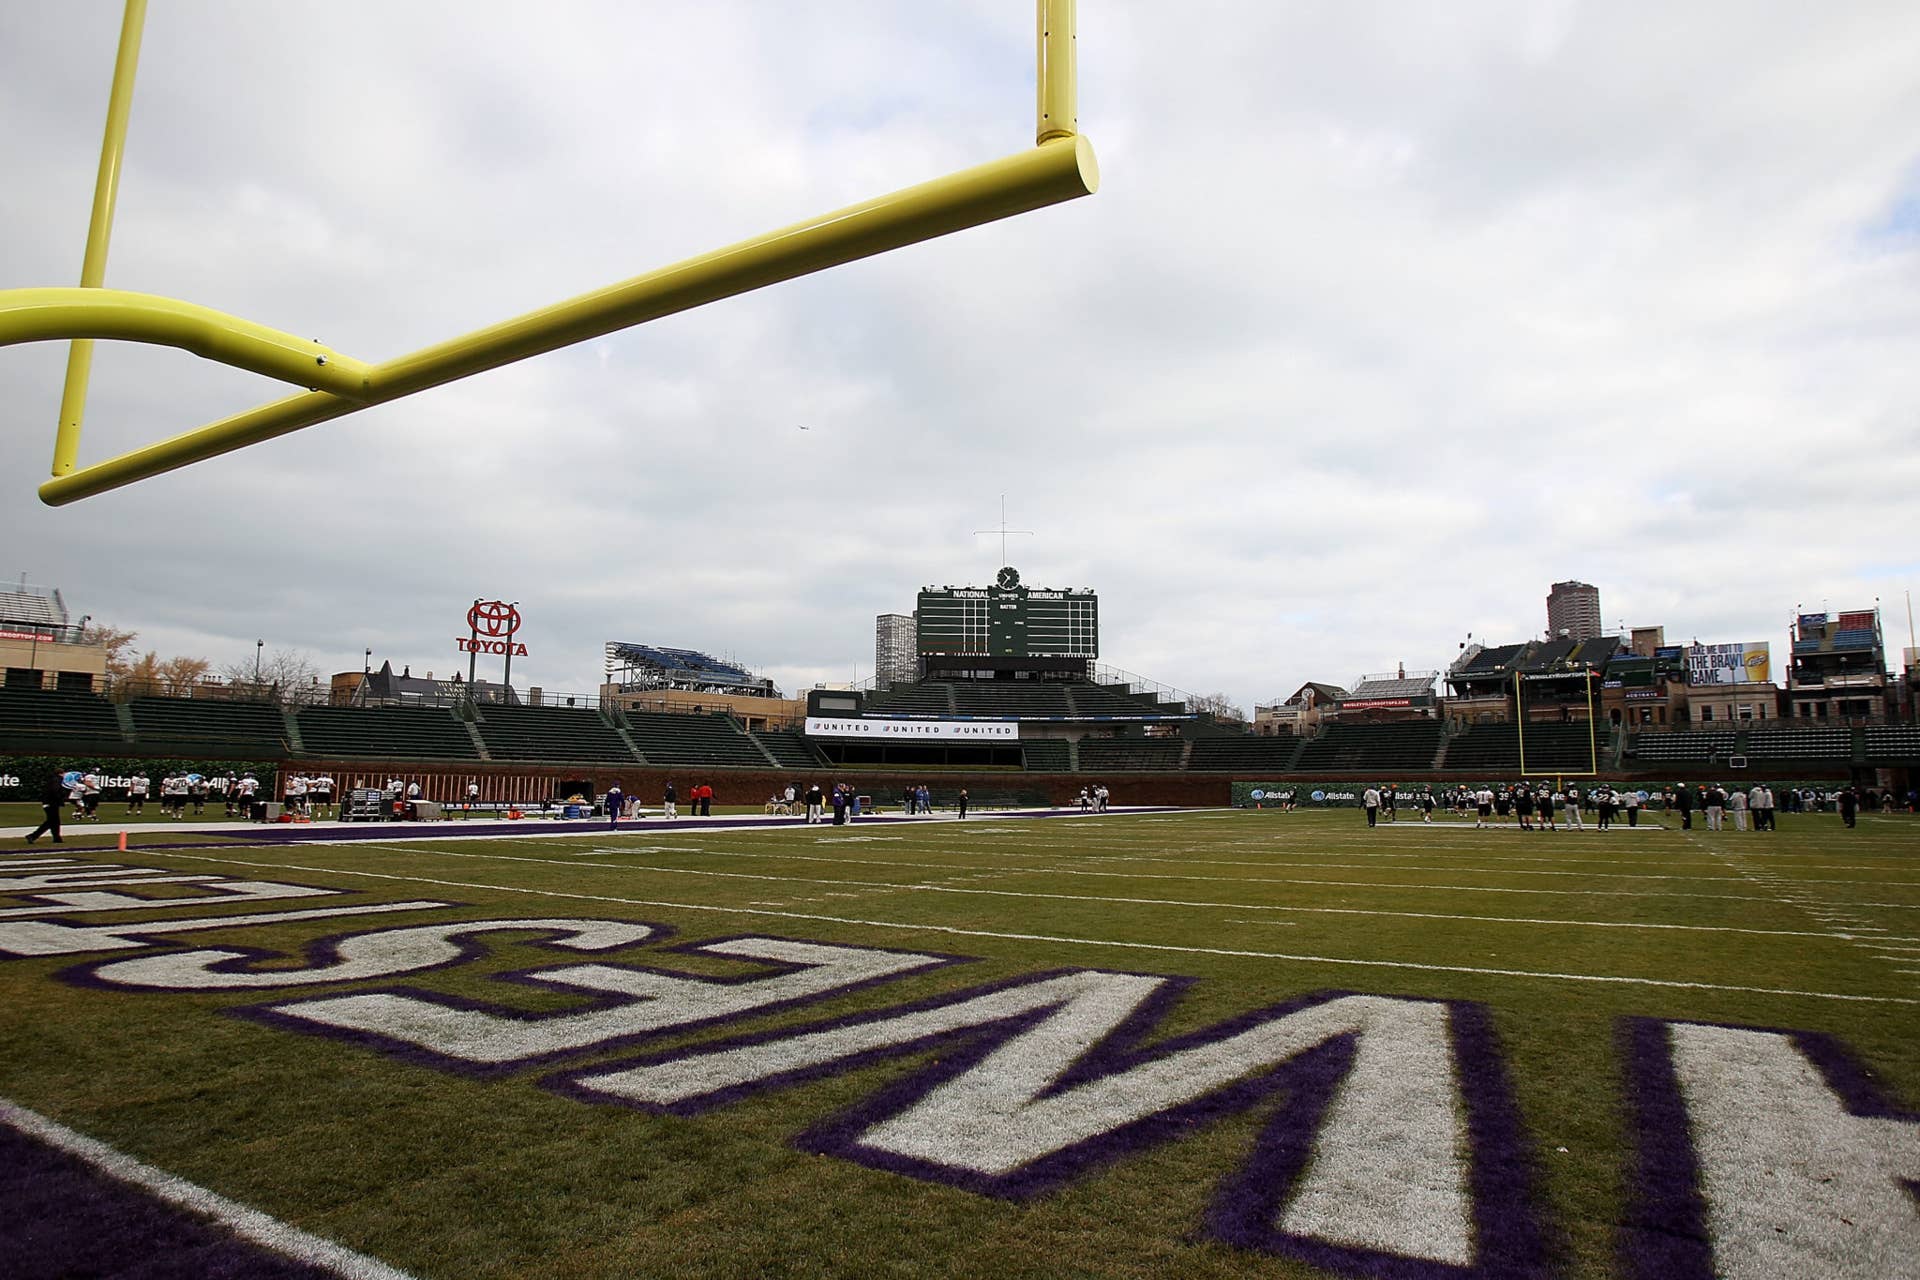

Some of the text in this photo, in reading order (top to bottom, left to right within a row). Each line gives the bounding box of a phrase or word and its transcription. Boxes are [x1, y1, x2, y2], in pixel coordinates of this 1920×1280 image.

[952, 590, 991, 599] NATIONAL
[1027, 592, 1064, 600] AMERICAN
[456, 638, 529, 657] TOYOTA
[1690, 643, 1744, 656] TAKE ME OUT TO
[1688, 656, 1709, 670] THE
[1711, 653, 1745, 669] BRAWL
[1691, 669, 1724, 685] GAME.
[823, 722, 870, 732] UNITED
[892, 725, 940, 735] UNITED
[963, 726, 1012, 735] UNITED
[1325, 792, 1356, 801] Allstate
[1498, 792, 1510, 801] 39
